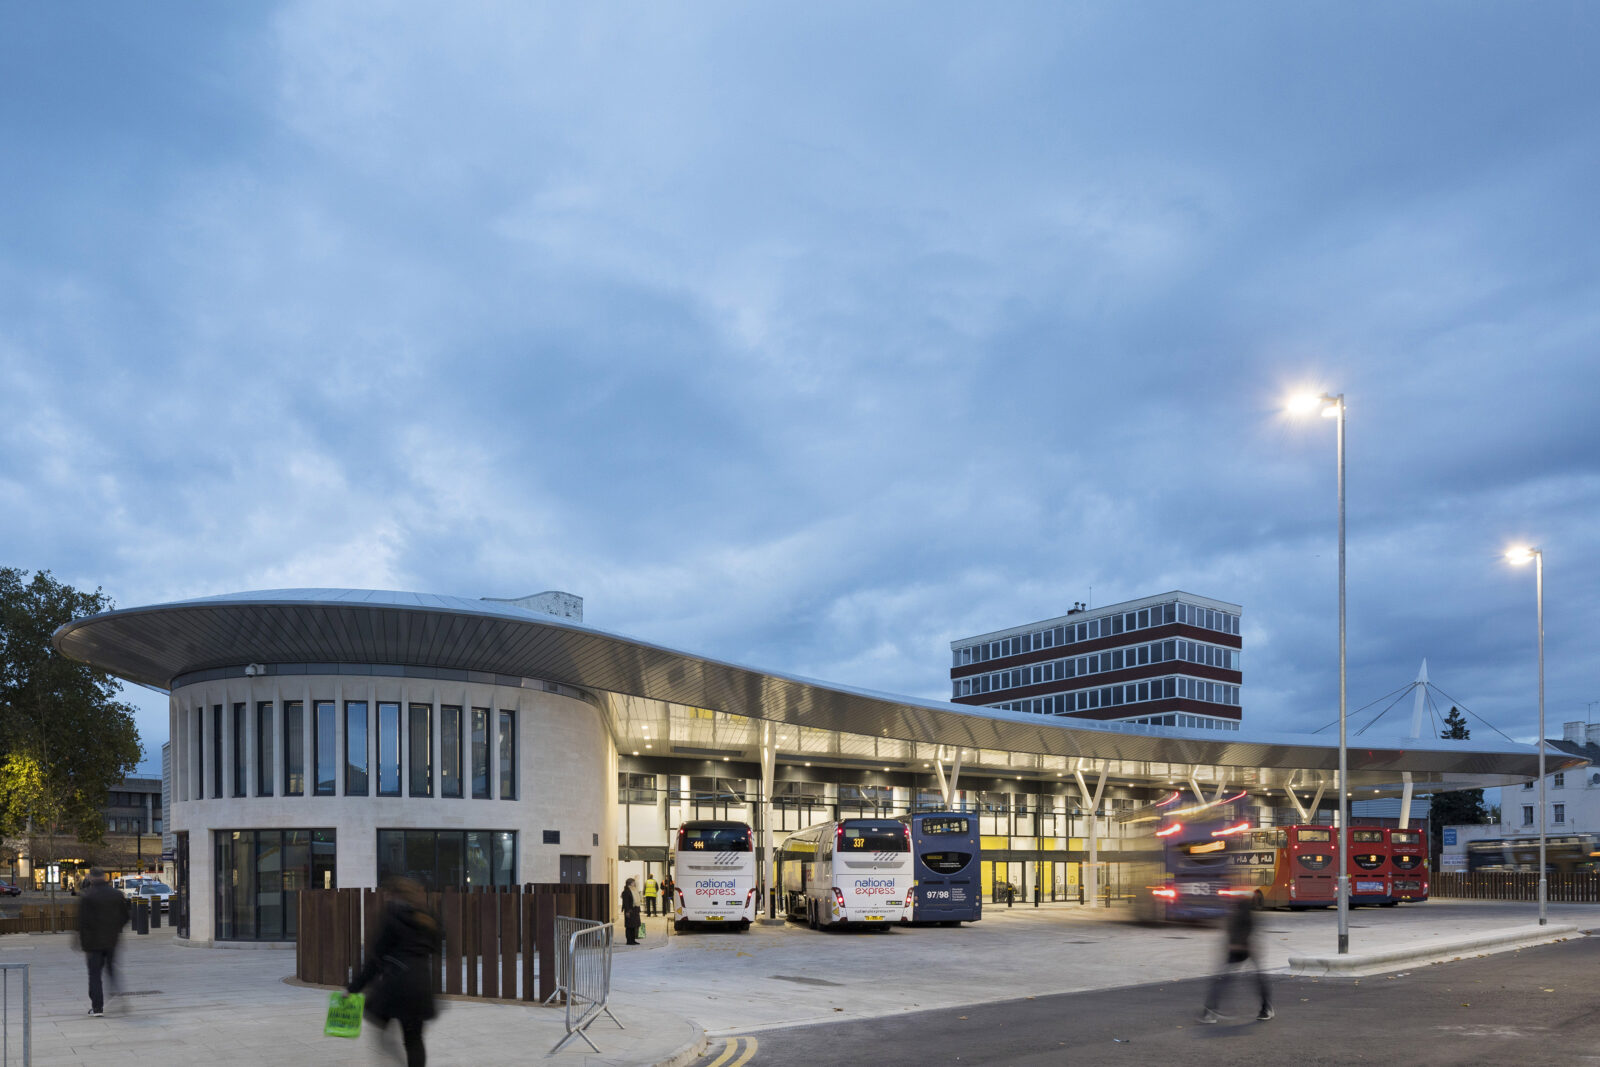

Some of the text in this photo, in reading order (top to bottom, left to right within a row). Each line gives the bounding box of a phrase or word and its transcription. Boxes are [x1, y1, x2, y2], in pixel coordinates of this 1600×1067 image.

[694, 841, 704, 849] 444
[853, 838, 864, 848] 337
[695, 878, 736, 888] national
[855, 877, 895, 887] national
[695, 888, 736, 898] express
[855, 887, 896, 897] express
[927, 891, 949, 899] 97/98
